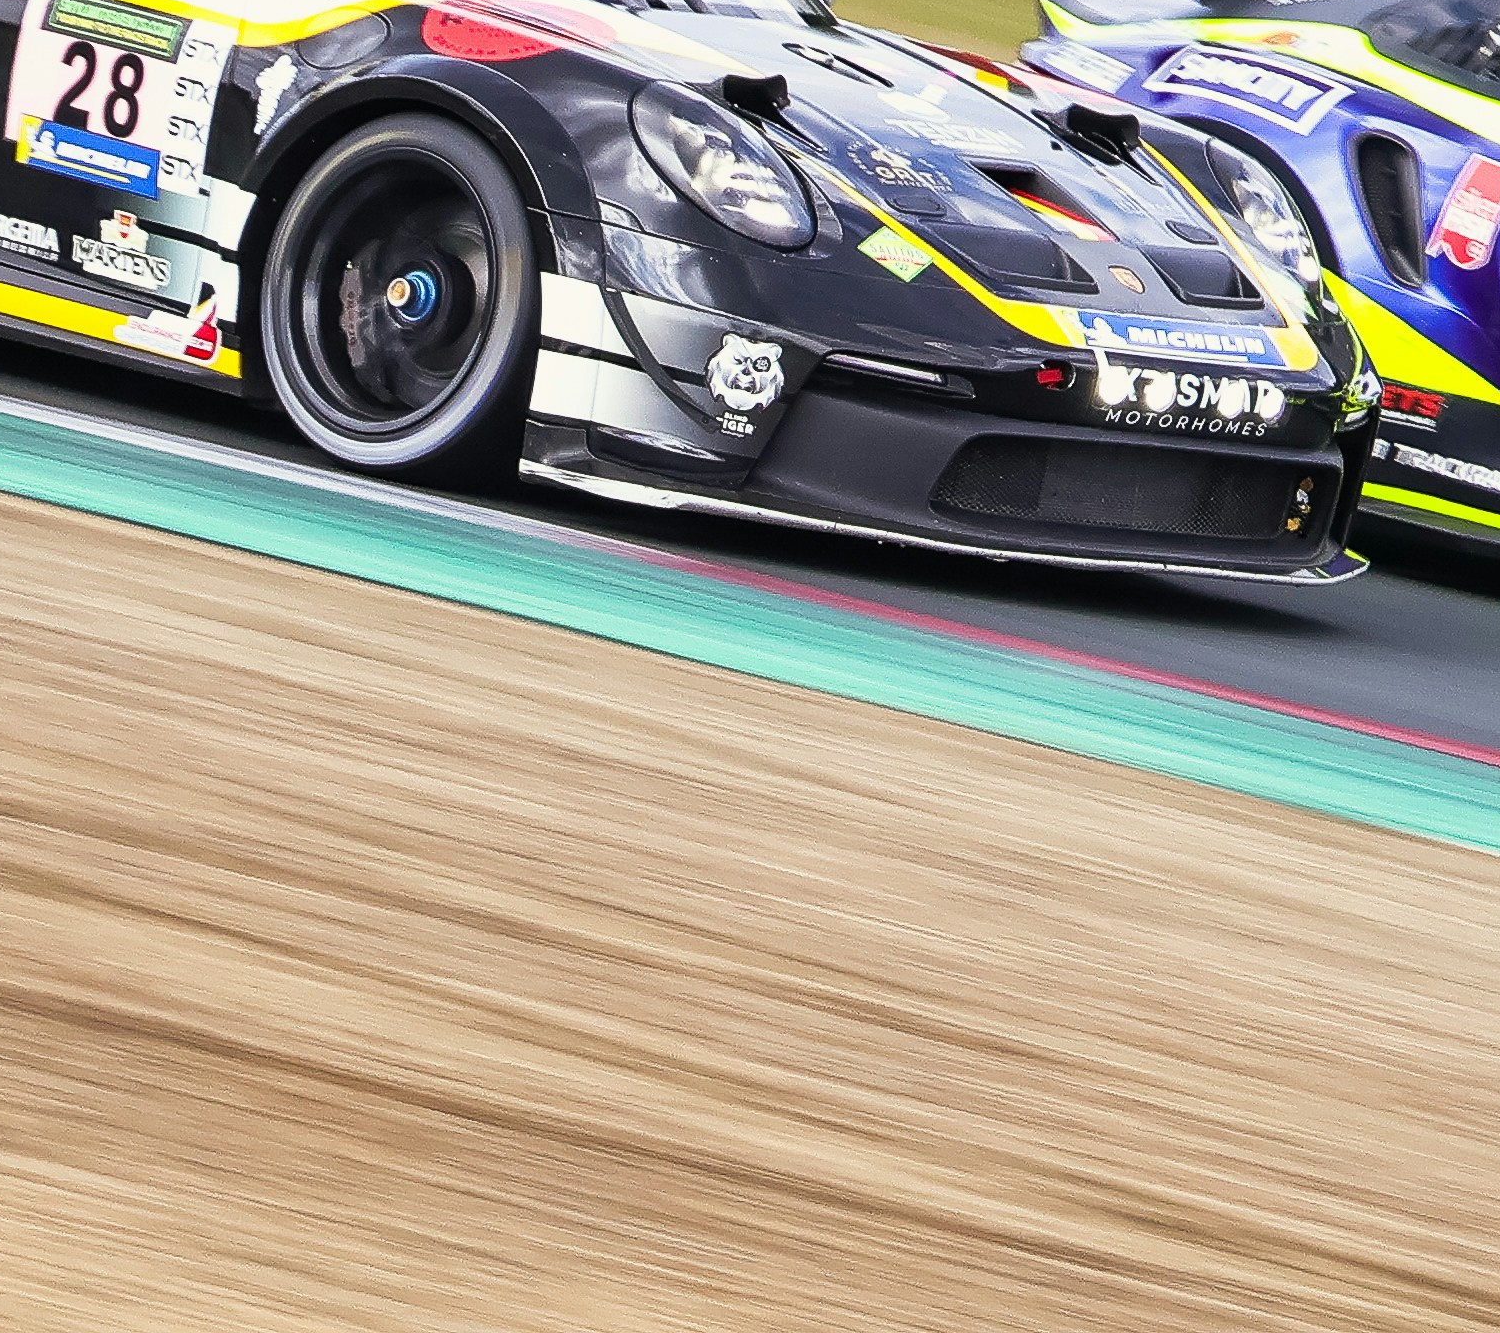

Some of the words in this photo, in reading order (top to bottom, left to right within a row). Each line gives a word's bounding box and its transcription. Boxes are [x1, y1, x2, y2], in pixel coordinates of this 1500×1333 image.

[53, 40, 145, 139] 28
[1127, 325, 1267, 356] MICHELIN
[1104, 408, 1268, 437] MOTORHOMES
